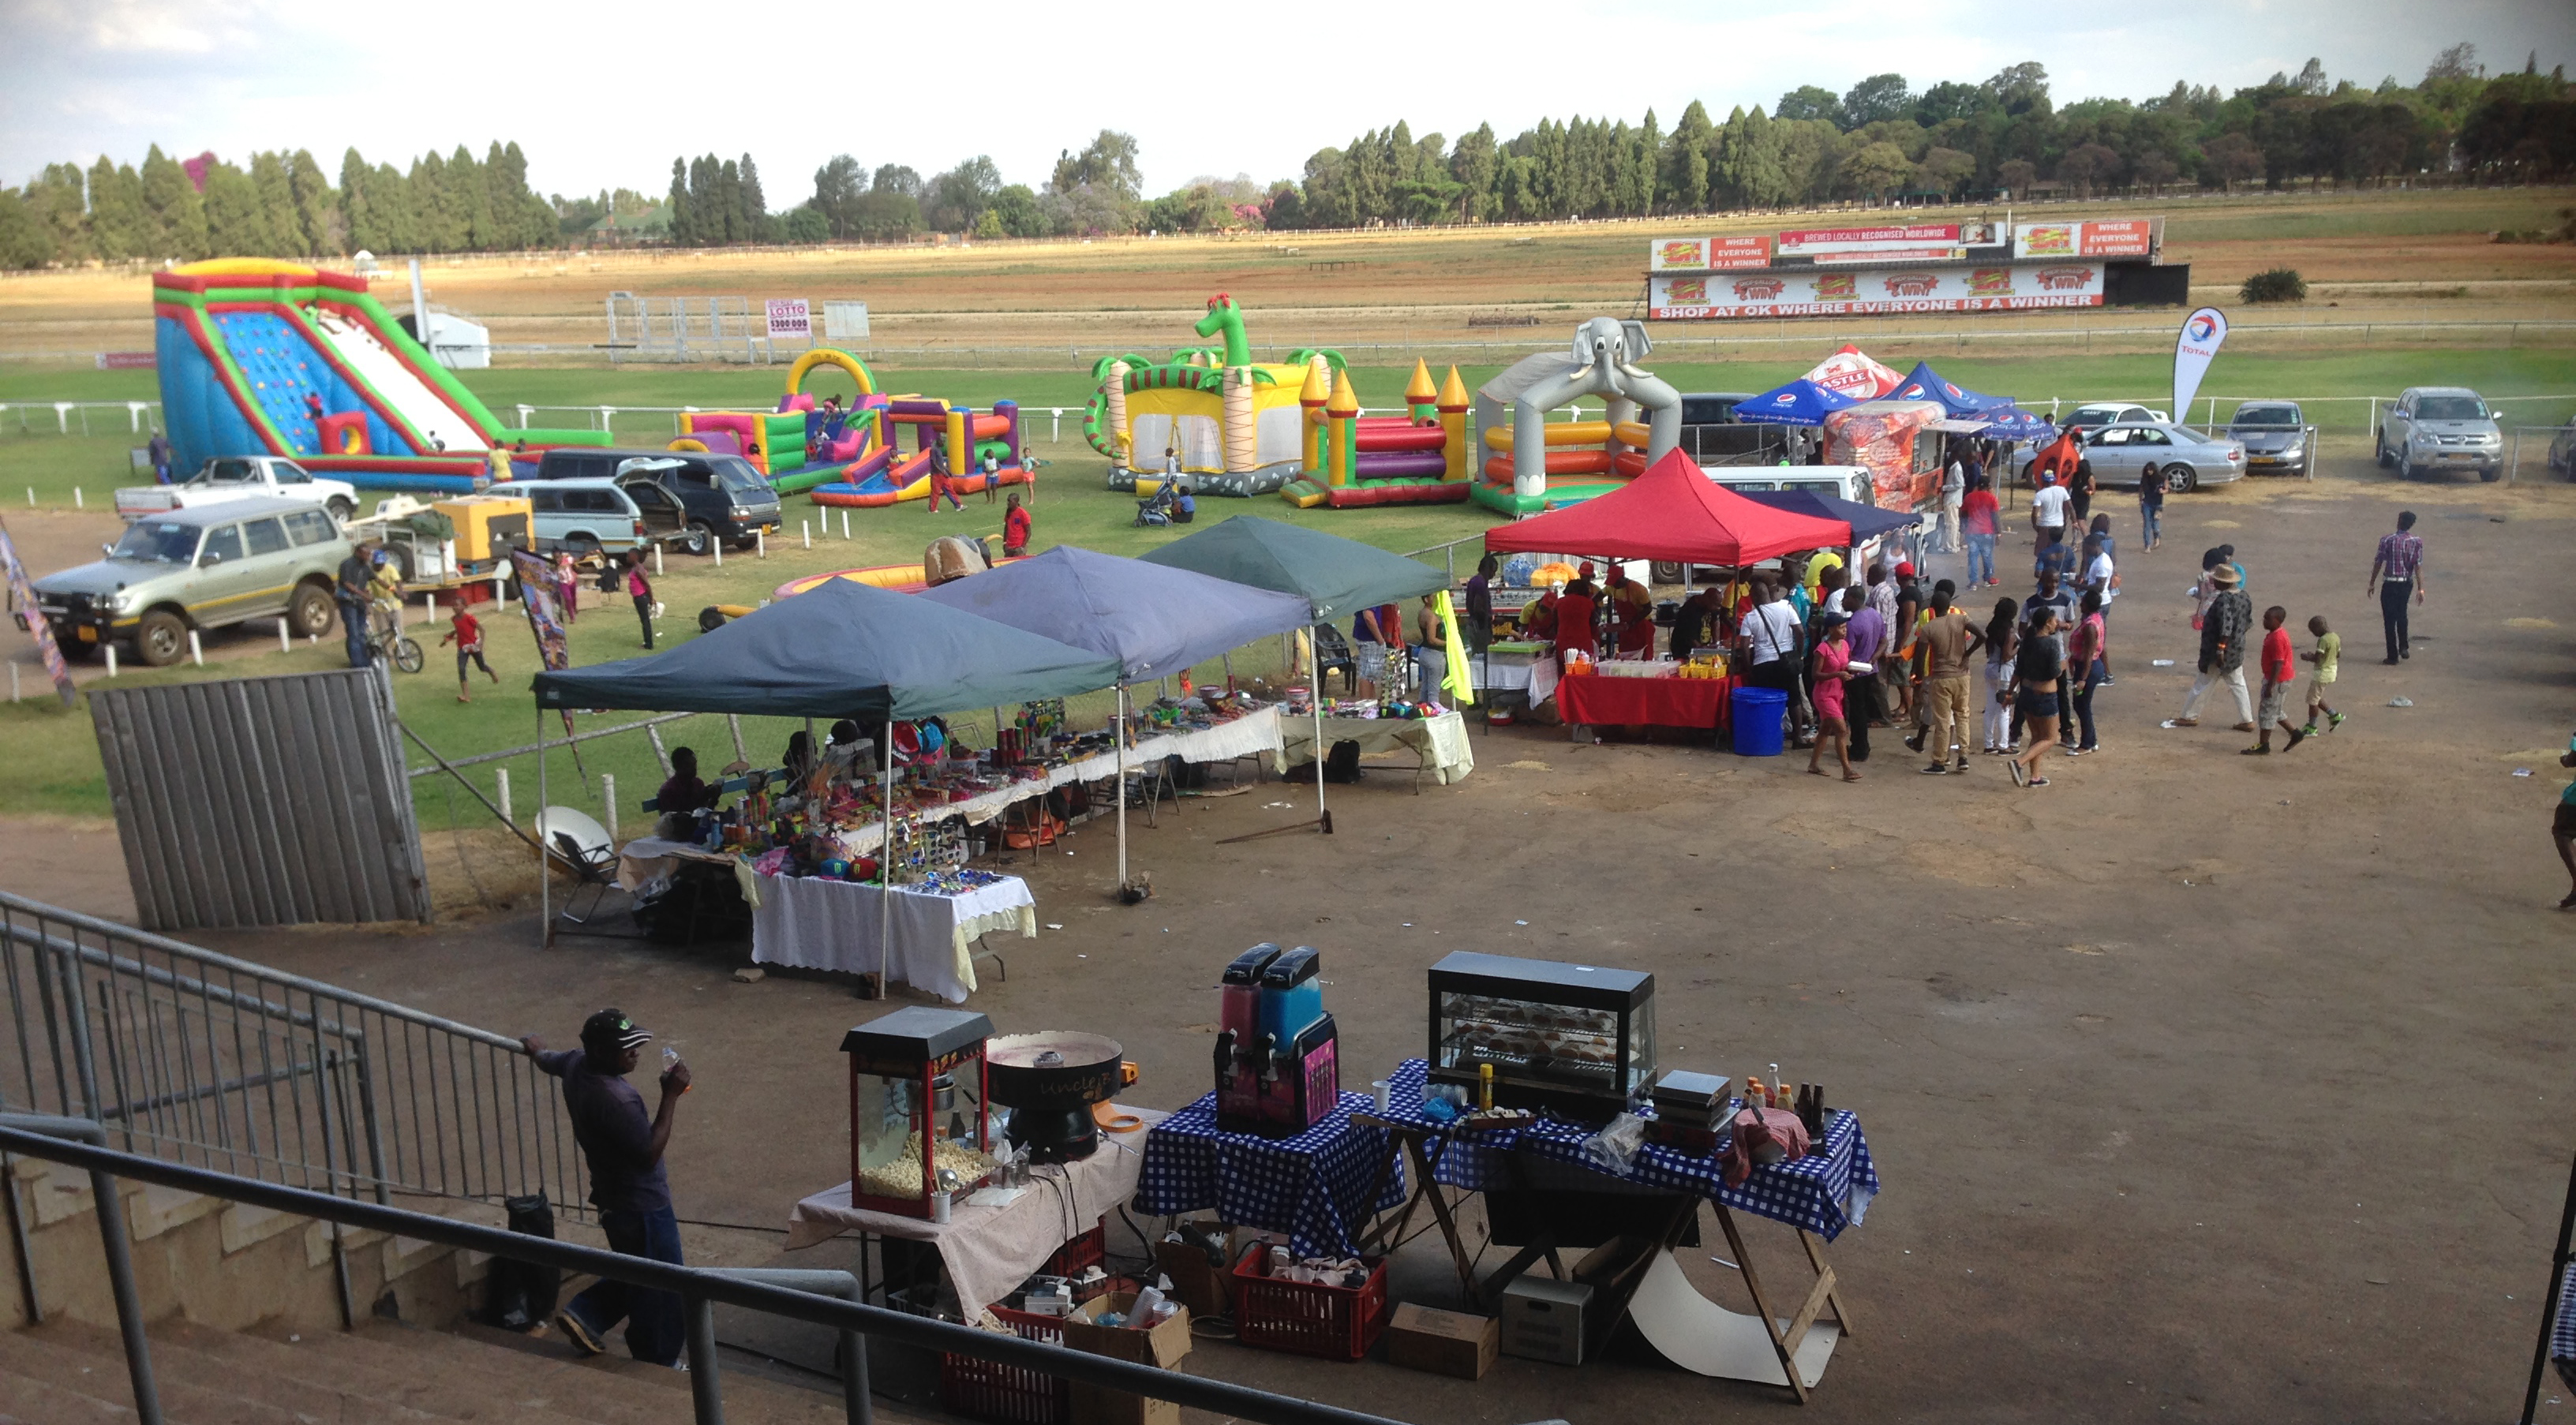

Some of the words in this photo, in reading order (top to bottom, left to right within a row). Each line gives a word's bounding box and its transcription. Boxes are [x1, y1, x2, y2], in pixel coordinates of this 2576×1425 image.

[2099, 223, 2132, 231] WHERE
[1804, 233, 1831, 242] BREWED
[1833, 232, 1859, 241] LOCALLY
[1862, 230, 1904, 240] RECOGNISED
[1905, 228, 1946, 238] WORLDWIDE
[2089, 234, 2140, 242] EVERYONE
[1718, 249, 1763, 257] EVERYONE
[770, 305, 806, 316] LOTTO
[1659, 307, 1710, 318] SHOP
[1714, 306, 1739, 317] AT
[1744, 305, 1772, 316] OK
[1777, 303, 1846, 315] WHERE
[1852, 300, 1958, 313] EVERYONE
[1964, 299, 1983, 309] IS
[1988, 298, 2003, 309] A
[2008, 295, 2092, 309] WINNER
[770, 319, 790, 327] $300
[792, 319, 807, 327] 000
[2181, 345, 2212, 357] TOTAL
[1822, 372, 1866, 388] ASTLE
[1990, 422, 2021, 431] pepsi
